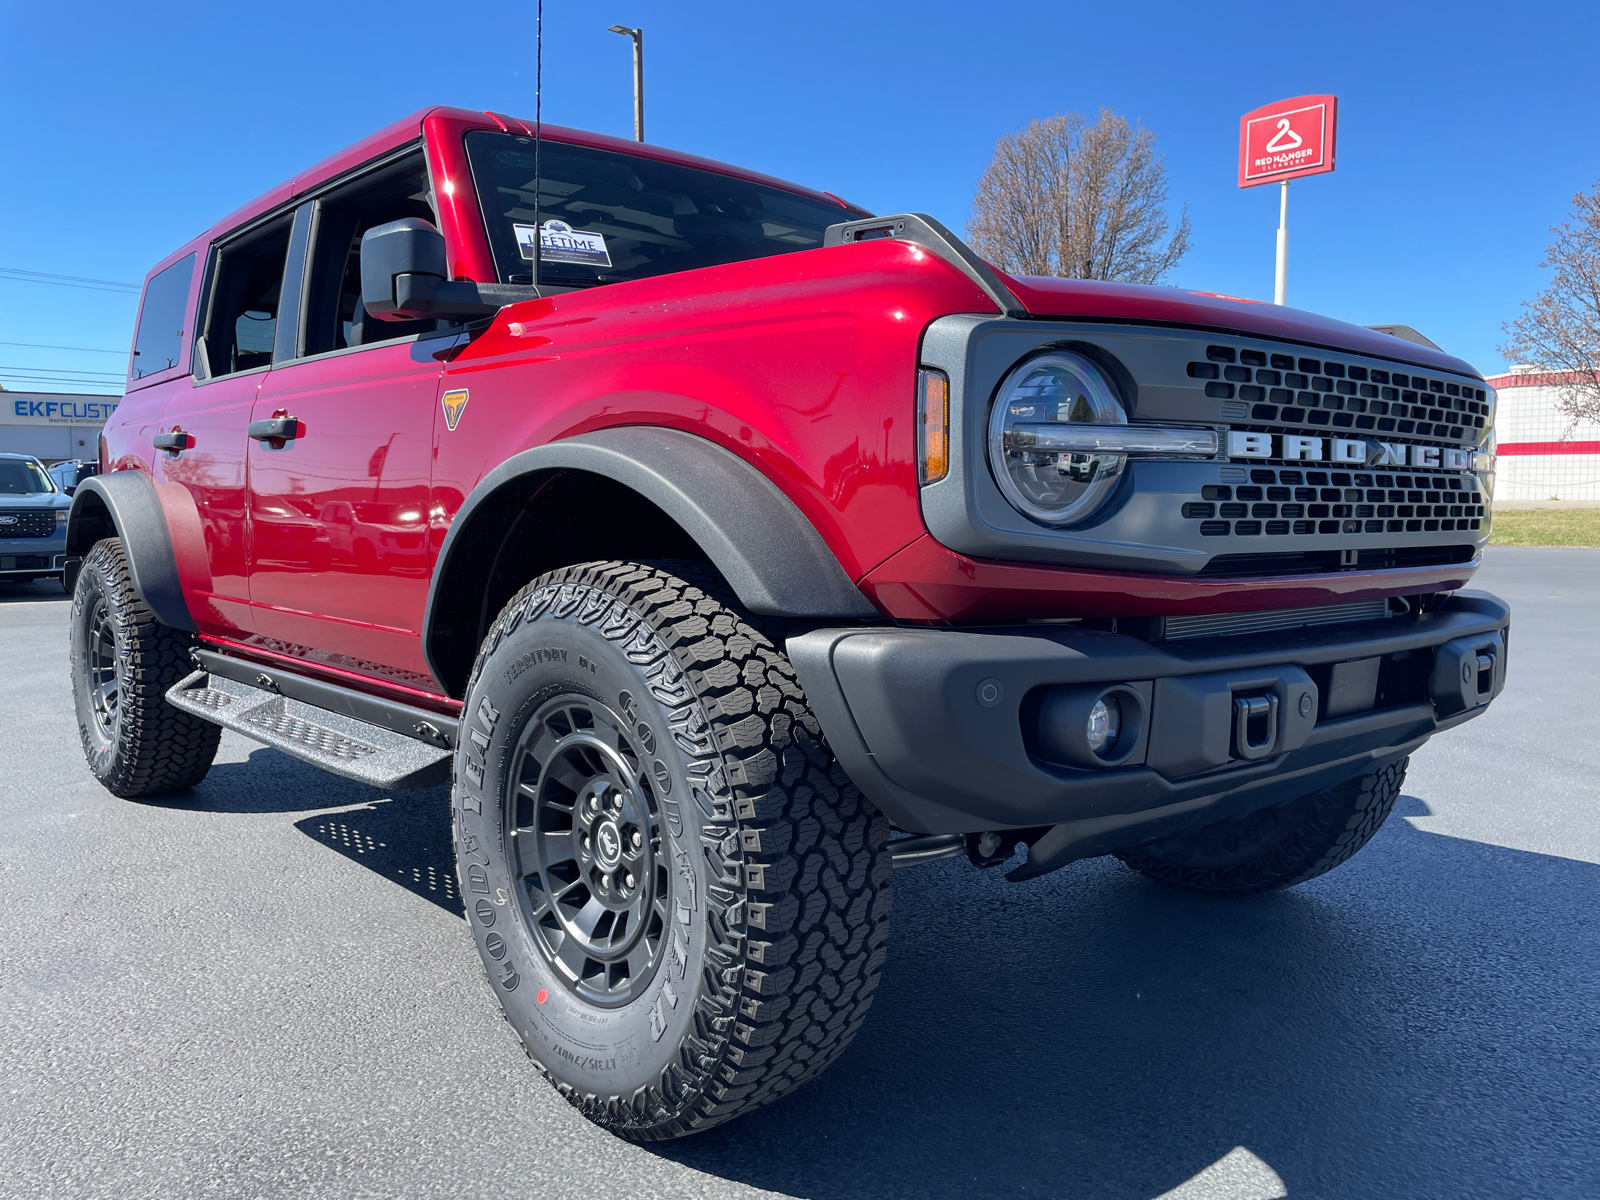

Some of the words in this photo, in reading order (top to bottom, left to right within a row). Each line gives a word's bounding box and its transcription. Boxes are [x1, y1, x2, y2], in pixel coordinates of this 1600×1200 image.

[1255, 157, 1273, 167] RED
[1262, 158, 1305, 171] CLEANERS
[527, 234, 596, 250] LFETIME
[1227, 430, 1467, 469] BRONCO
[503, 648, 568, 685] TERRITORY
[461, 696, 521, 992] GOODYEAR
[618, 689, 698, 1042] GOODYEAR
